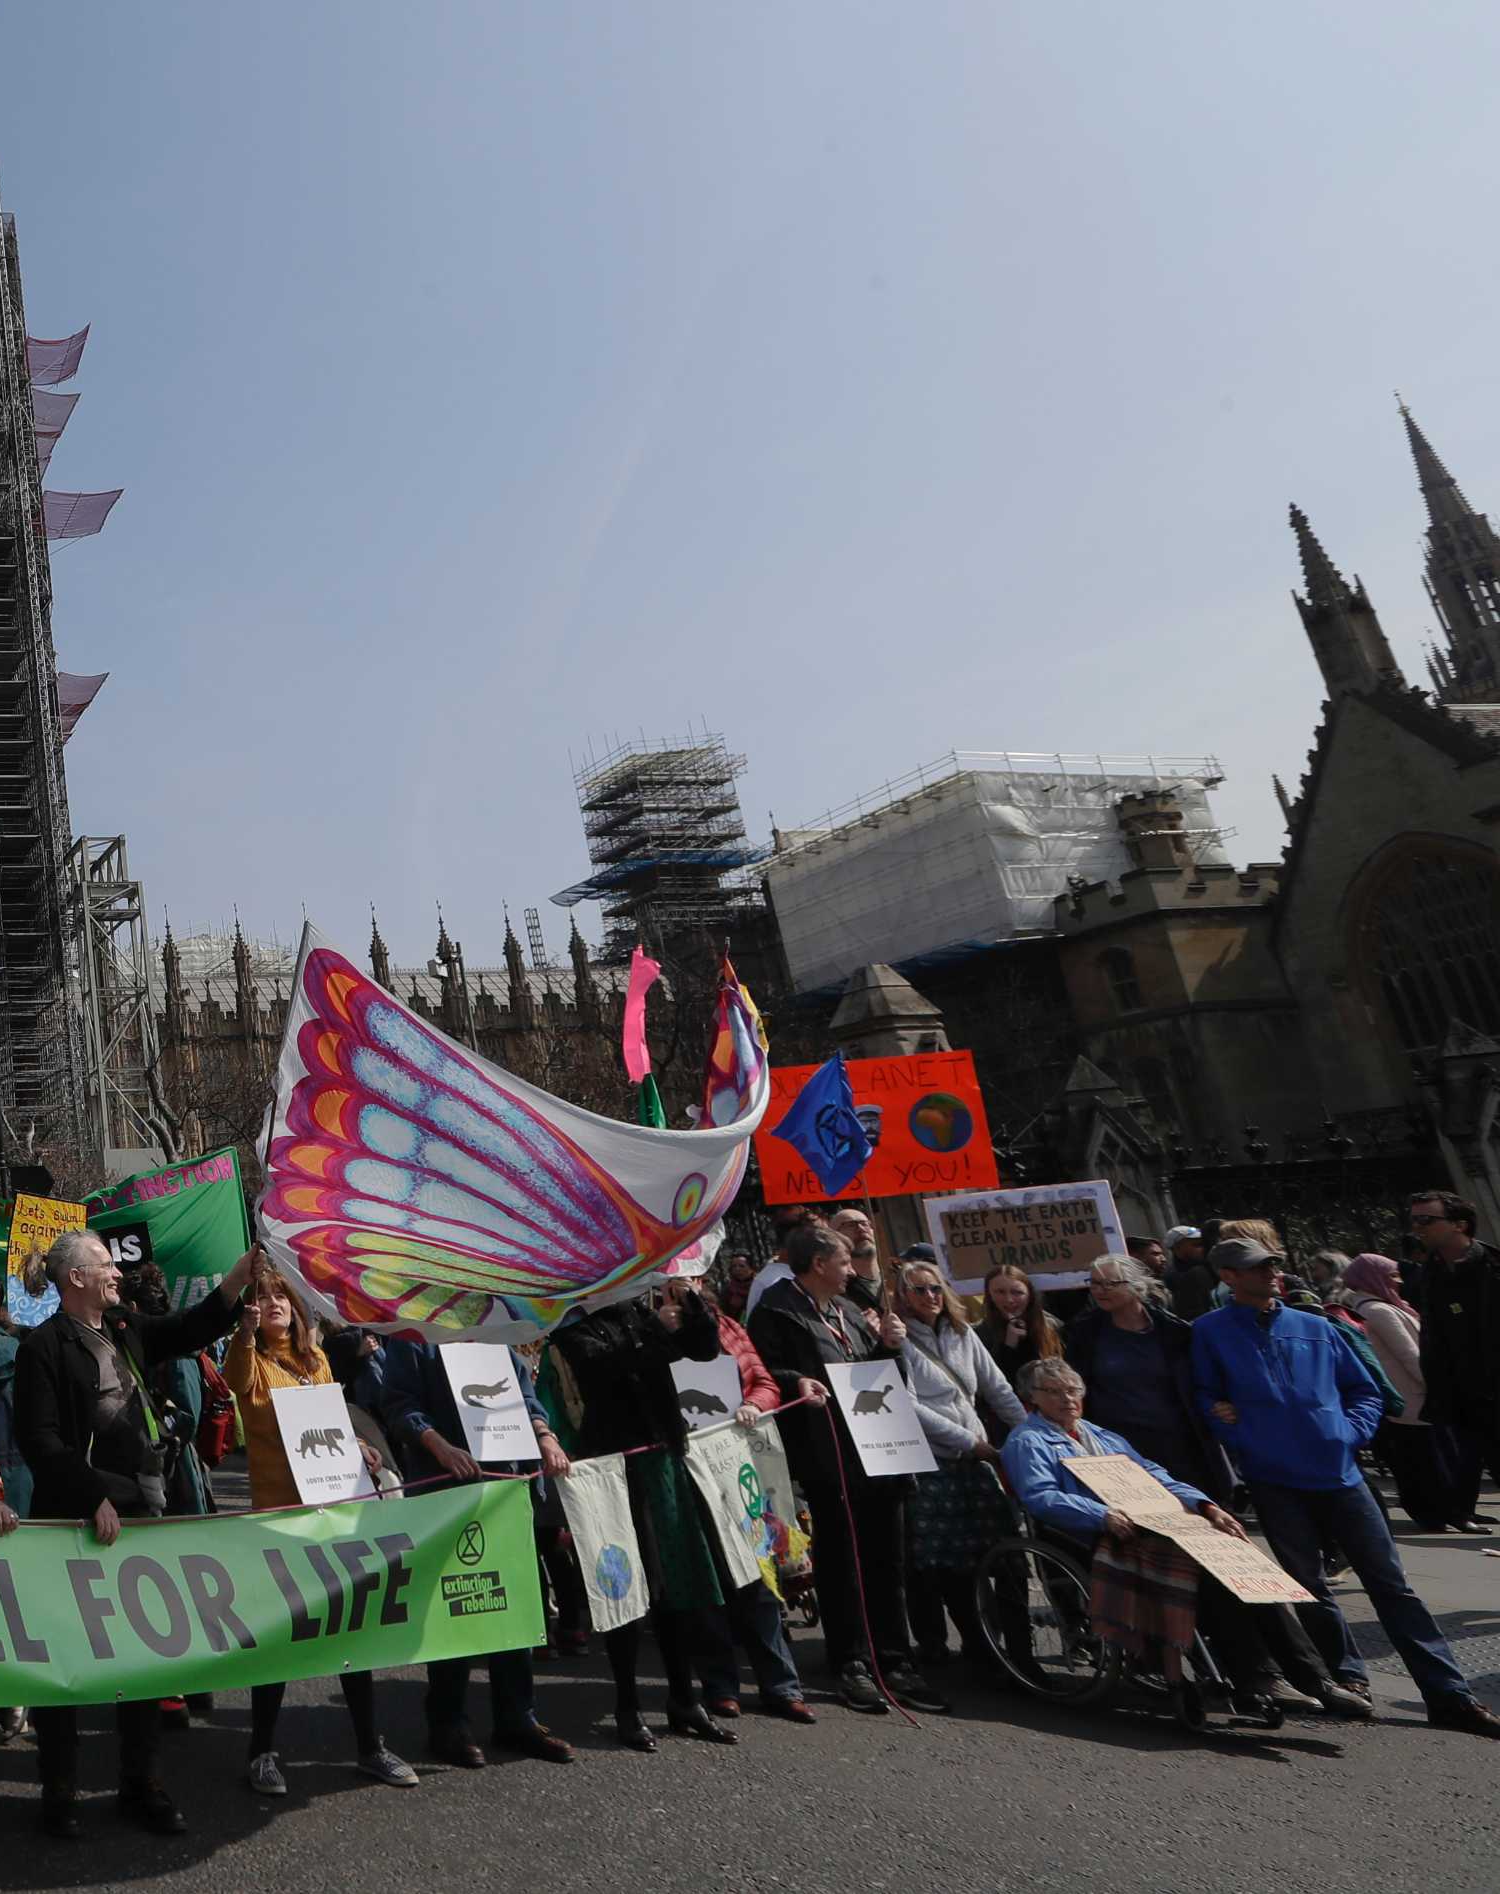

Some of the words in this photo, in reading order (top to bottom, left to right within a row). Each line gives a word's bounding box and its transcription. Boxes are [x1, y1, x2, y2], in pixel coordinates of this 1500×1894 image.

[893, 1152, 971, 1187] YOU!
[950, 1211, 990, 1231] KEEP
[996, 1205, 1035, 1226] THE
[1039, 1197, 1095, 1220] EARTH
[1062, 1217, 1100, 1236] NOT
[988, 1240, 1073, 1266] URANUS
[66, 1554, 257, 1660] FOR
[263, 1533, 414, 1643] LIFE
[444, 1573, 493, 1595] extinction
[462, 1590, 506, 1613] rebellion
